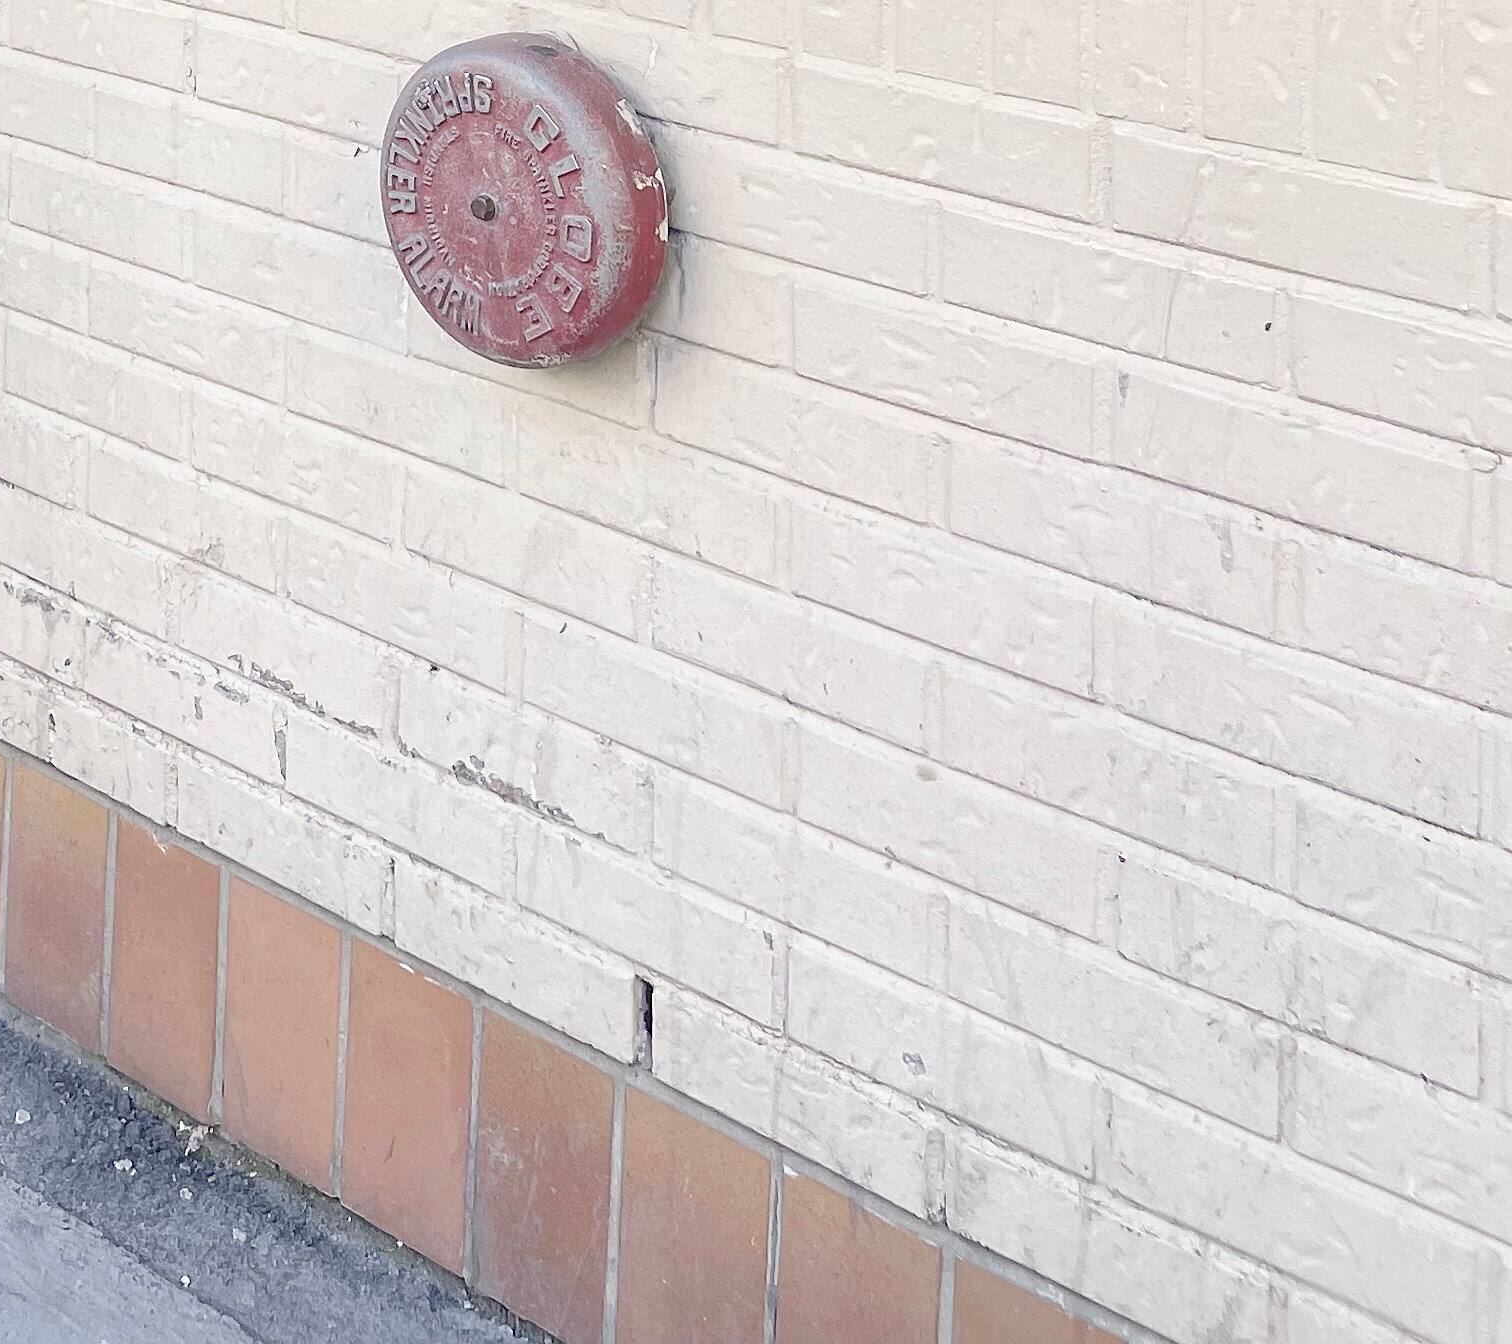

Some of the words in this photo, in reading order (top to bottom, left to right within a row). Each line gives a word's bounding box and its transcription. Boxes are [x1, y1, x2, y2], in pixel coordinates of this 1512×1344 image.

[387, 72, 494, 216] SPRINKLER
[397, 231, 484, 336] ALARM
[515, 104, 593, 342] GLOBE
